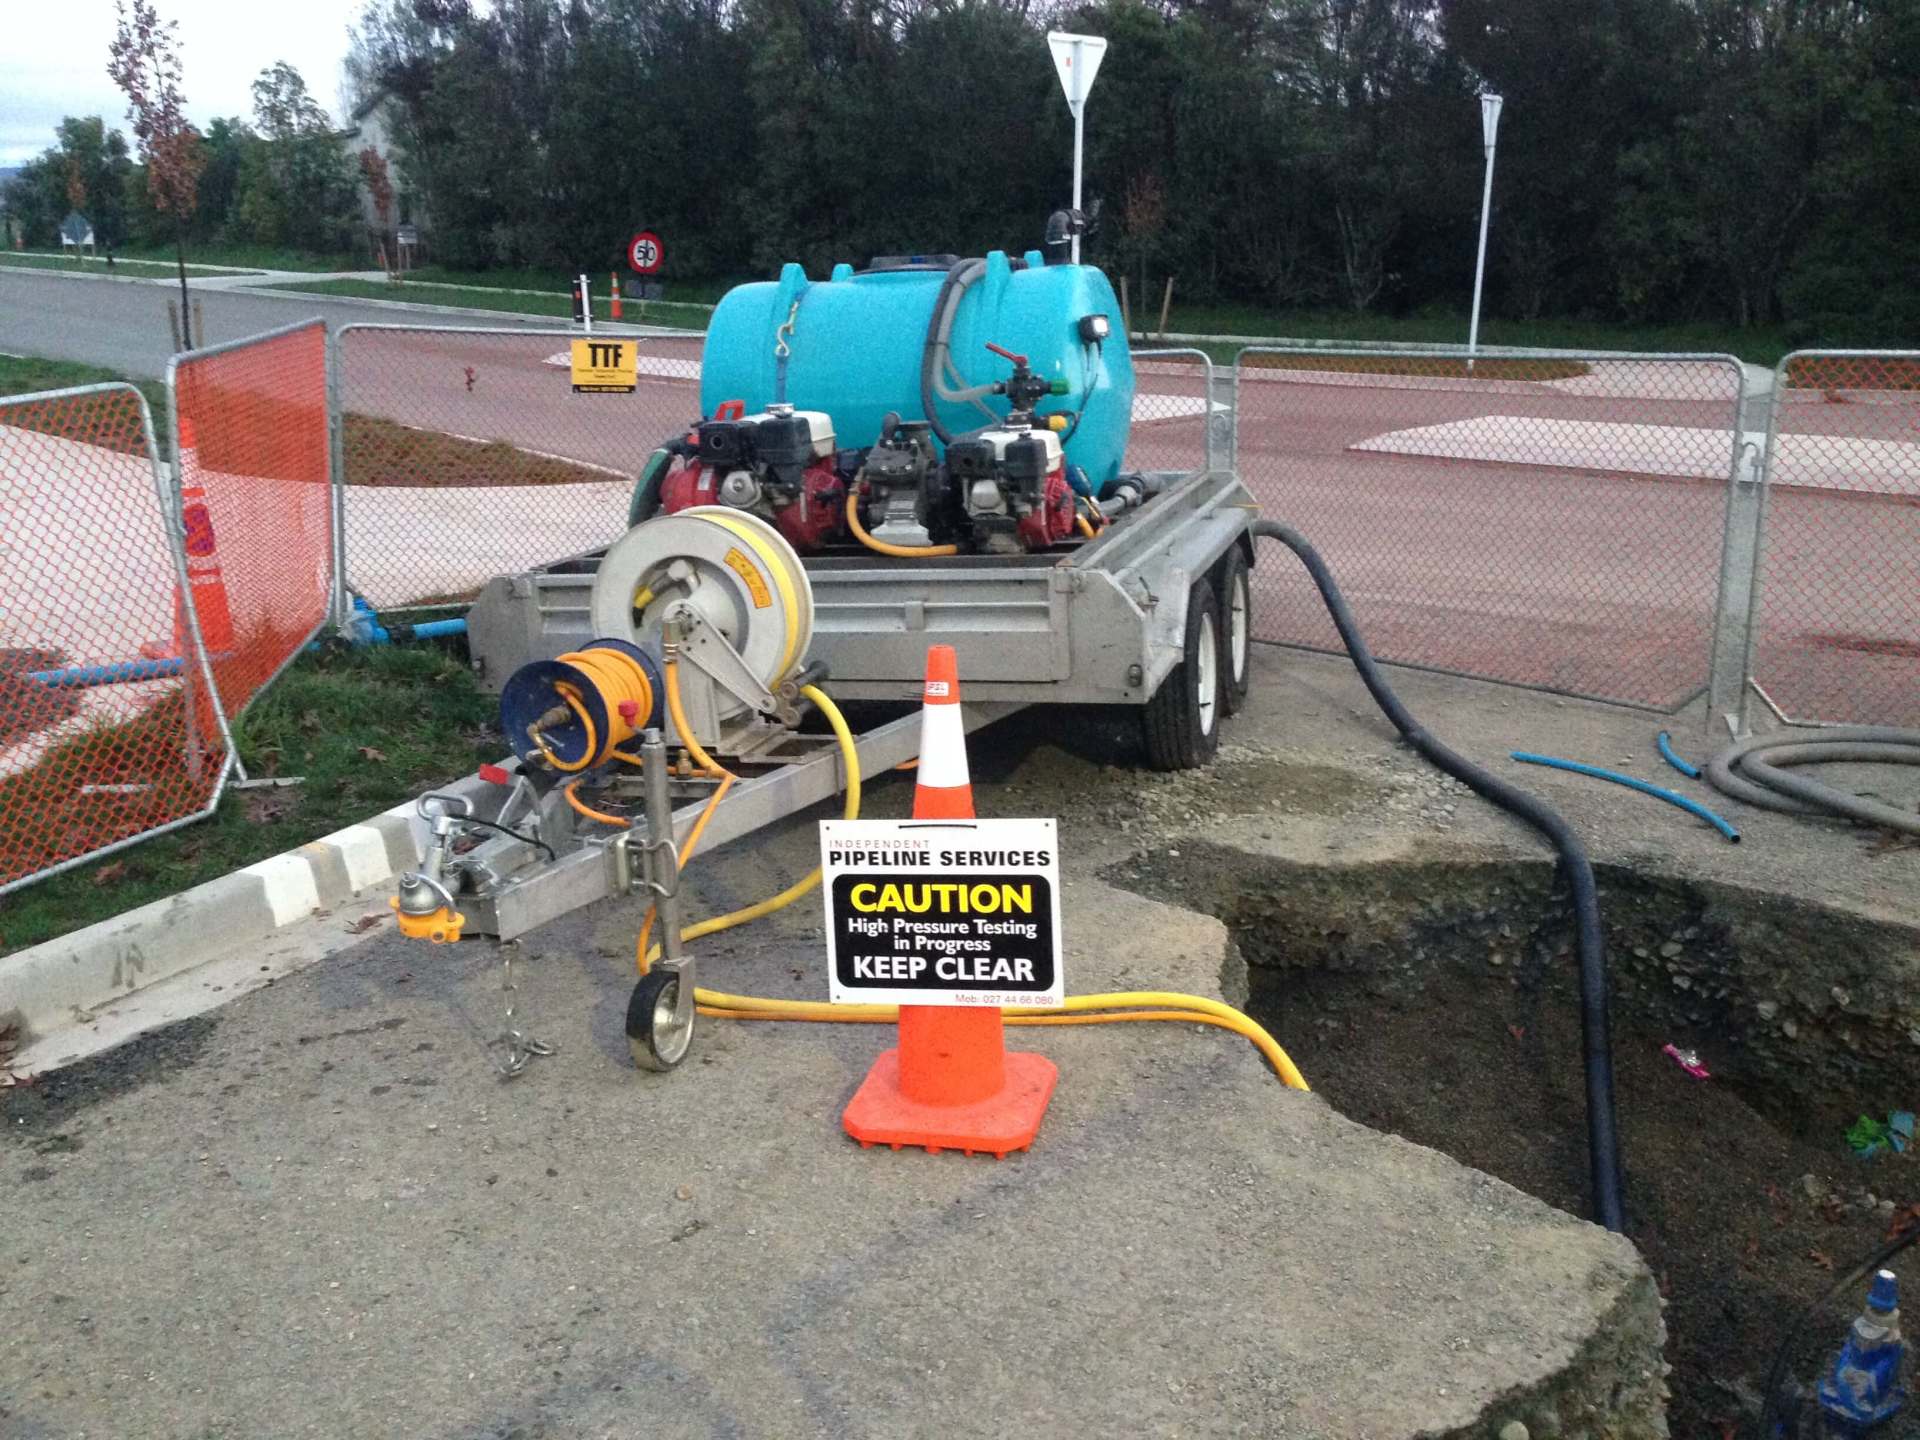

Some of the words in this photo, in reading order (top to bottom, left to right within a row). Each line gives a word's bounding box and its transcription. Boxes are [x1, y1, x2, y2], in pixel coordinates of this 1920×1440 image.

[637, 245, 656, 261] 50
[588, 344, 623, 367] TTF
[829, 840, 930, 849] INDEPENDENT
[830, 851, 931, 866] PIPELINE
[940, 851, 1050, 866] SERVICES
[850, 883, 1032, 913] CAUTION
[848, 918, 889, 935] High
[894, 919, 969, 934] Pressure
[974, 919, 1037, 939] Testing
[894, 936, 910, 950] in
[916, 936, 991, 954] Progress
[854, 956, 927, 979] KEEP
[935, 957, 1034, 982] CLEAR
[983, 995, 1001, 1003] 027
[1005, 996, 1017, 1004] 44
